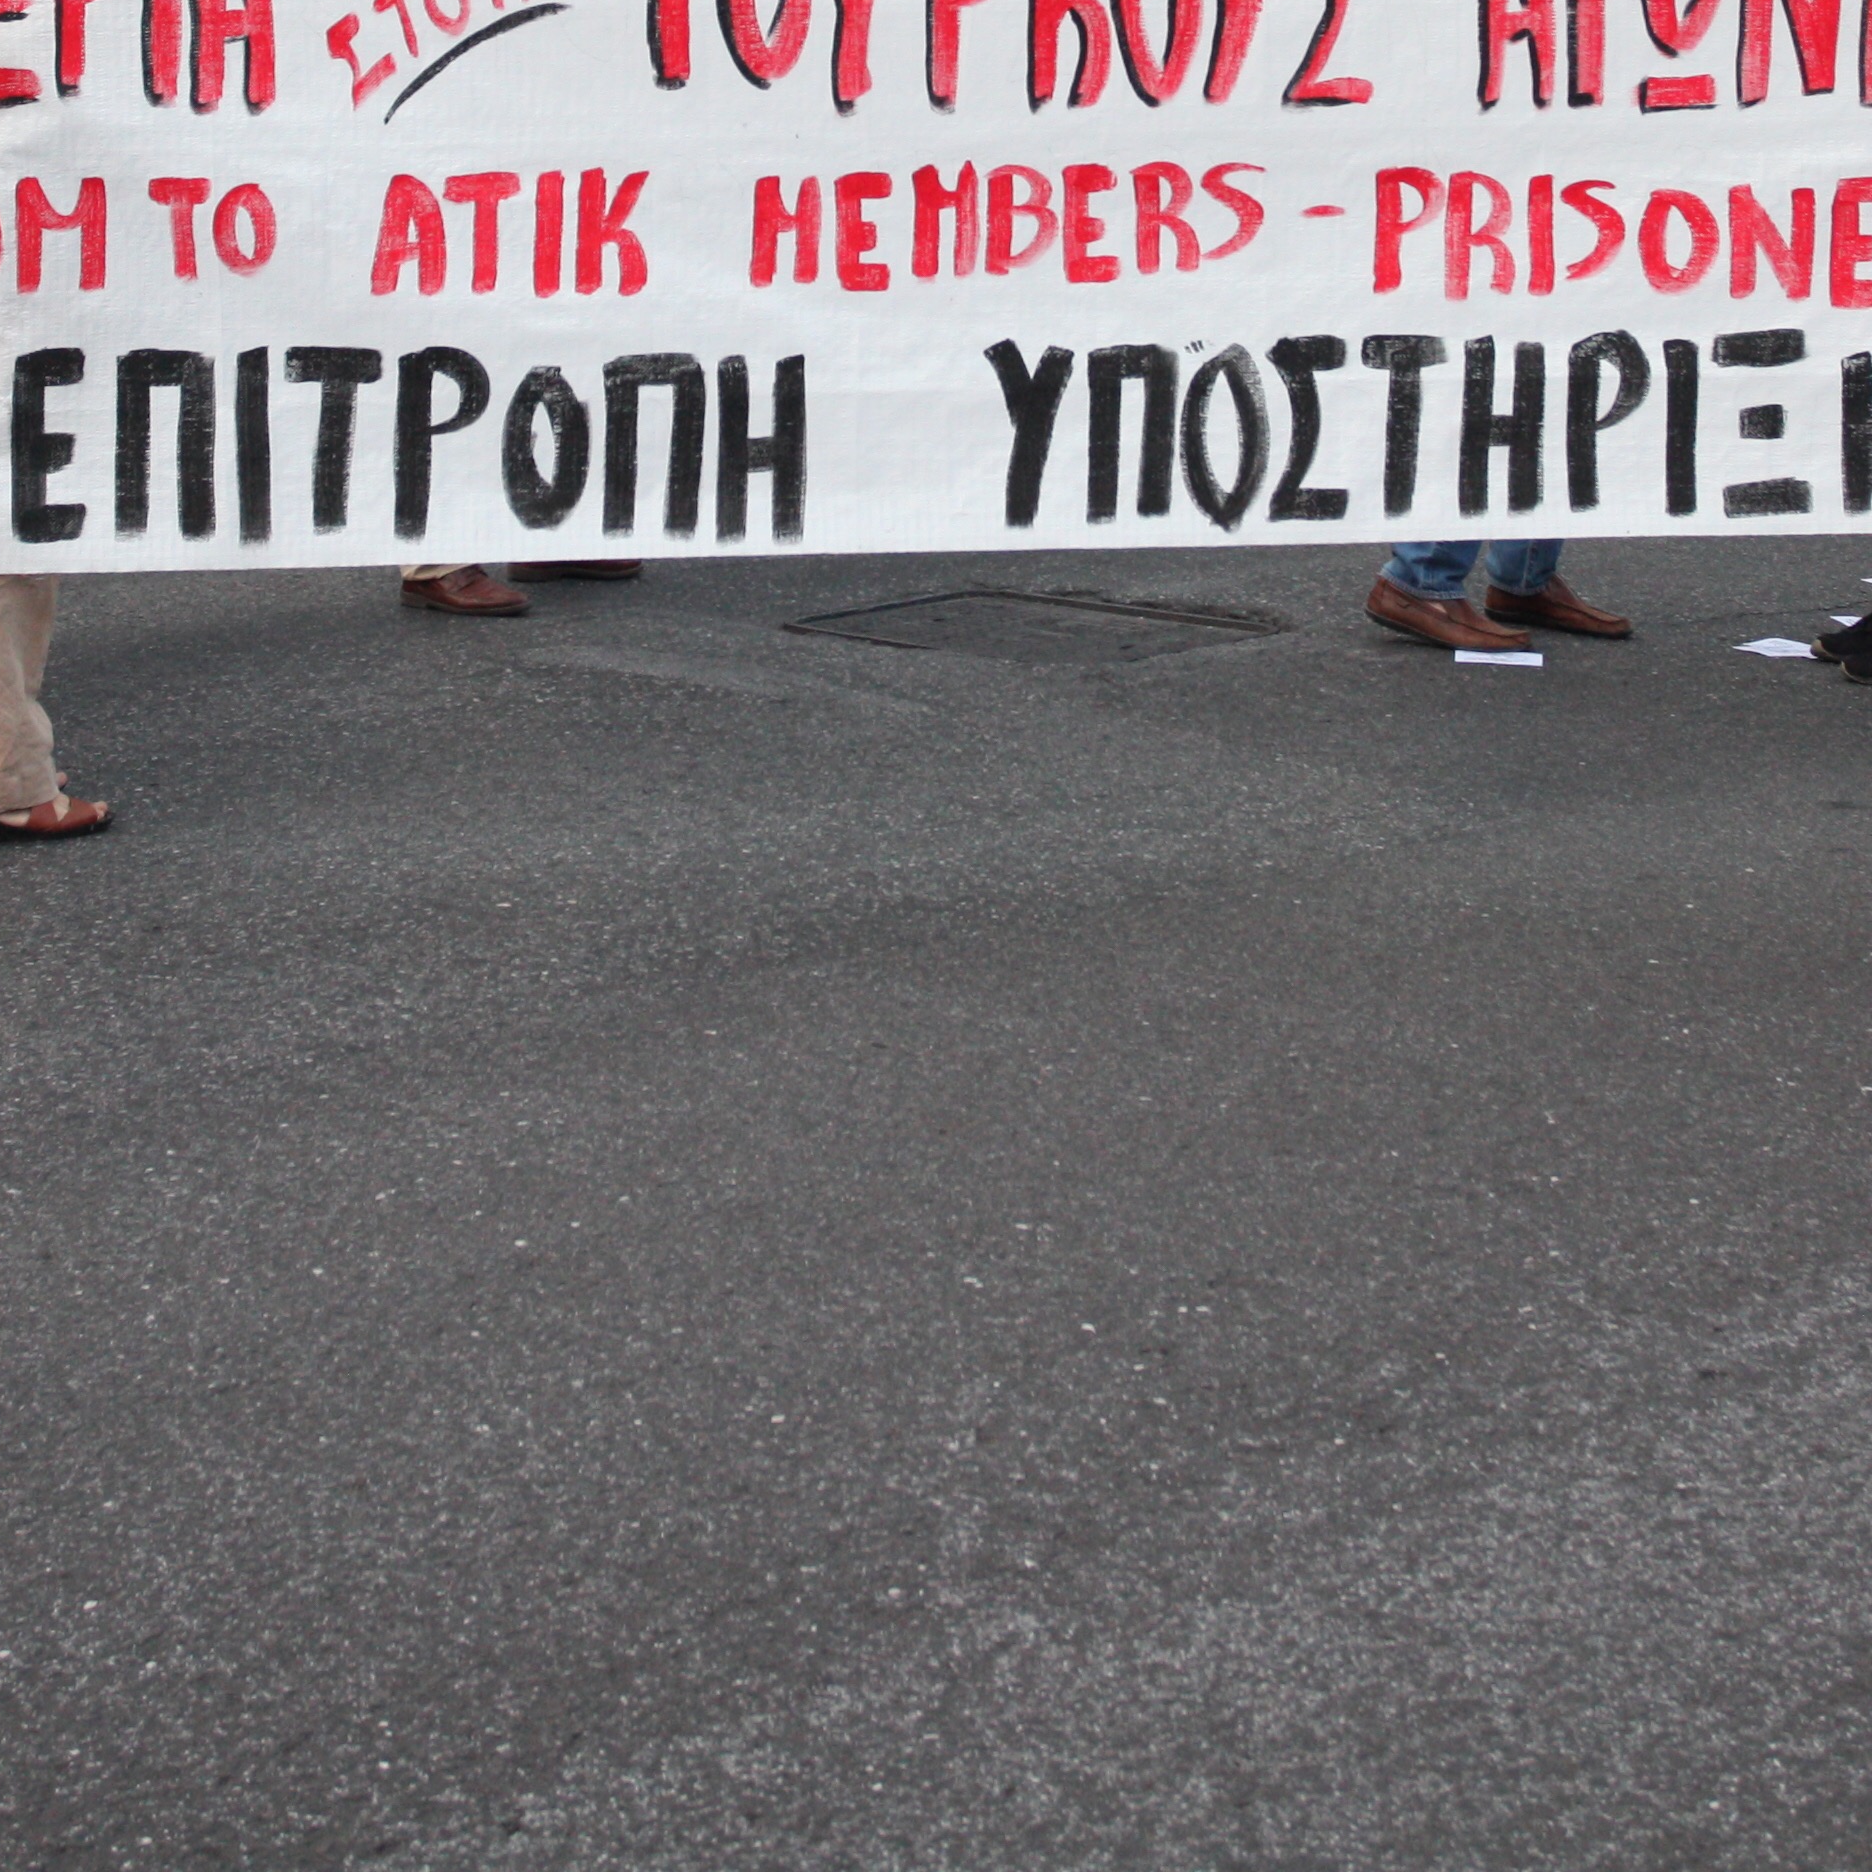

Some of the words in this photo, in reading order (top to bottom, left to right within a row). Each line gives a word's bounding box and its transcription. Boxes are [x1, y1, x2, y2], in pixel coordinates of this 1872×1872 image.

[149, 177, 276, 279] TO
[372, 168, 649, 298] ATIK
[750, 161, 1264, 292] MEMBERS
[11, 347, 805, 543] ΕΠΙΤΡΟΠΗ
